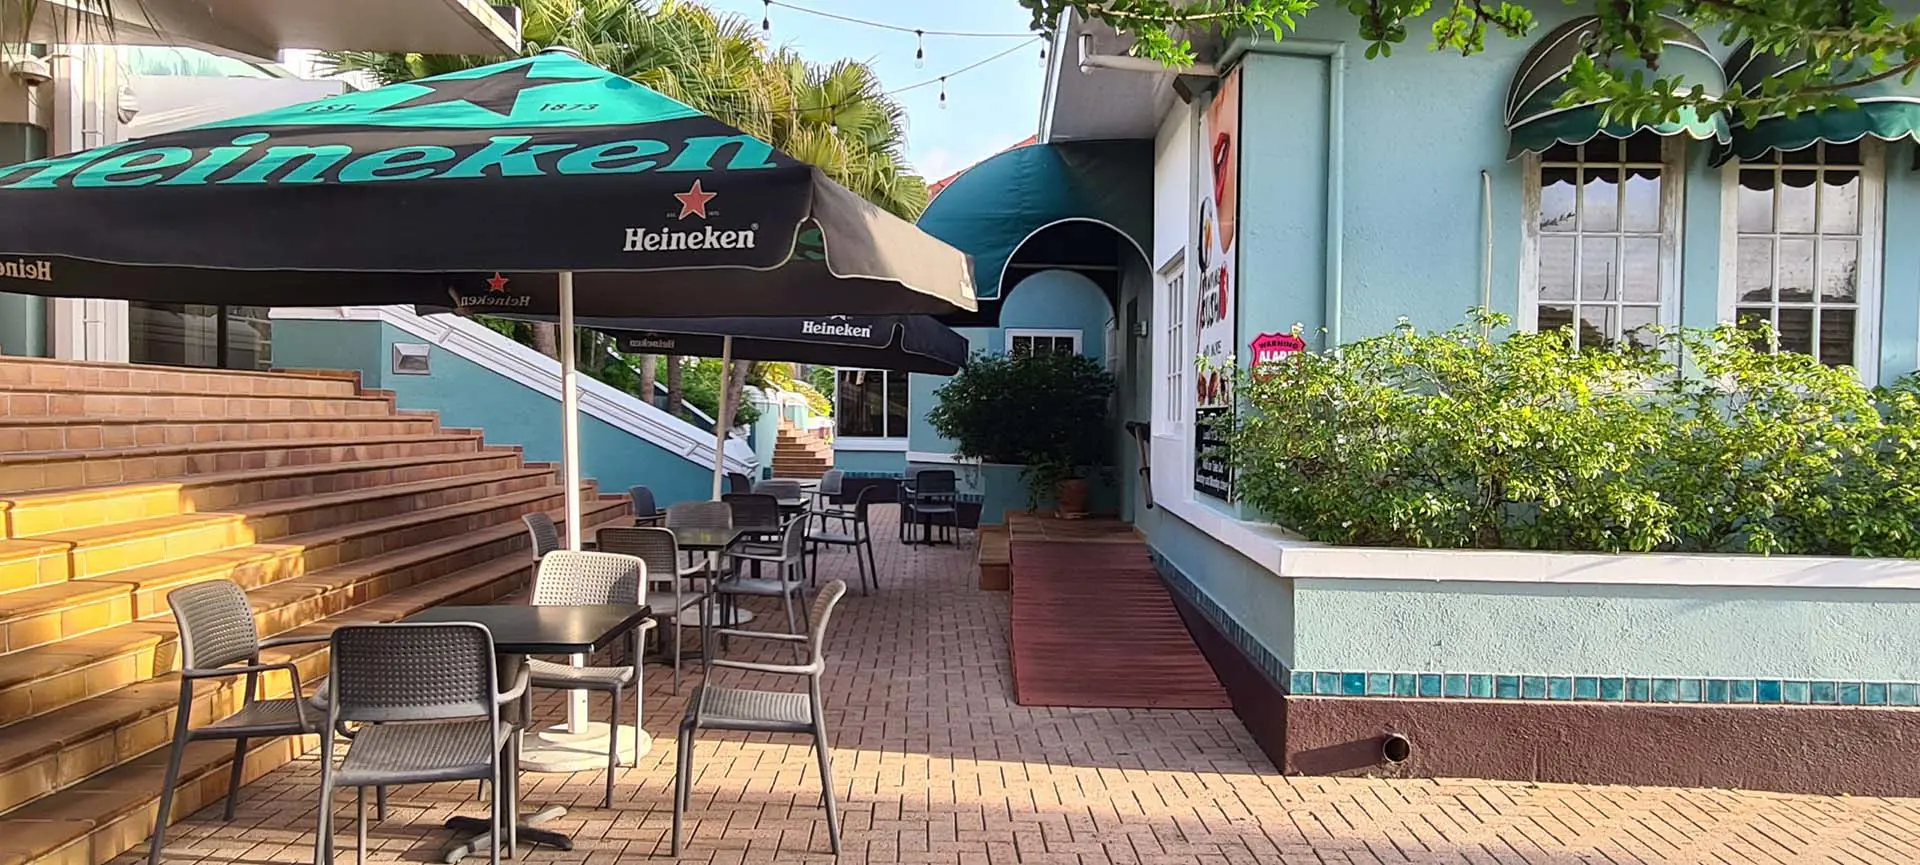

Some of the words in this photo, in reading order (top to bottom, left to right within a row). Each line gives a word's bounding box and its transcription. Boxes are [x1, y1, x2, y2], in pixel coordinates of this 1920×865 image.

[540, 103, 599, 111] 1873
[623, 225, 756, 251] Heineken
[802, 320, 871, 338] Heineken
